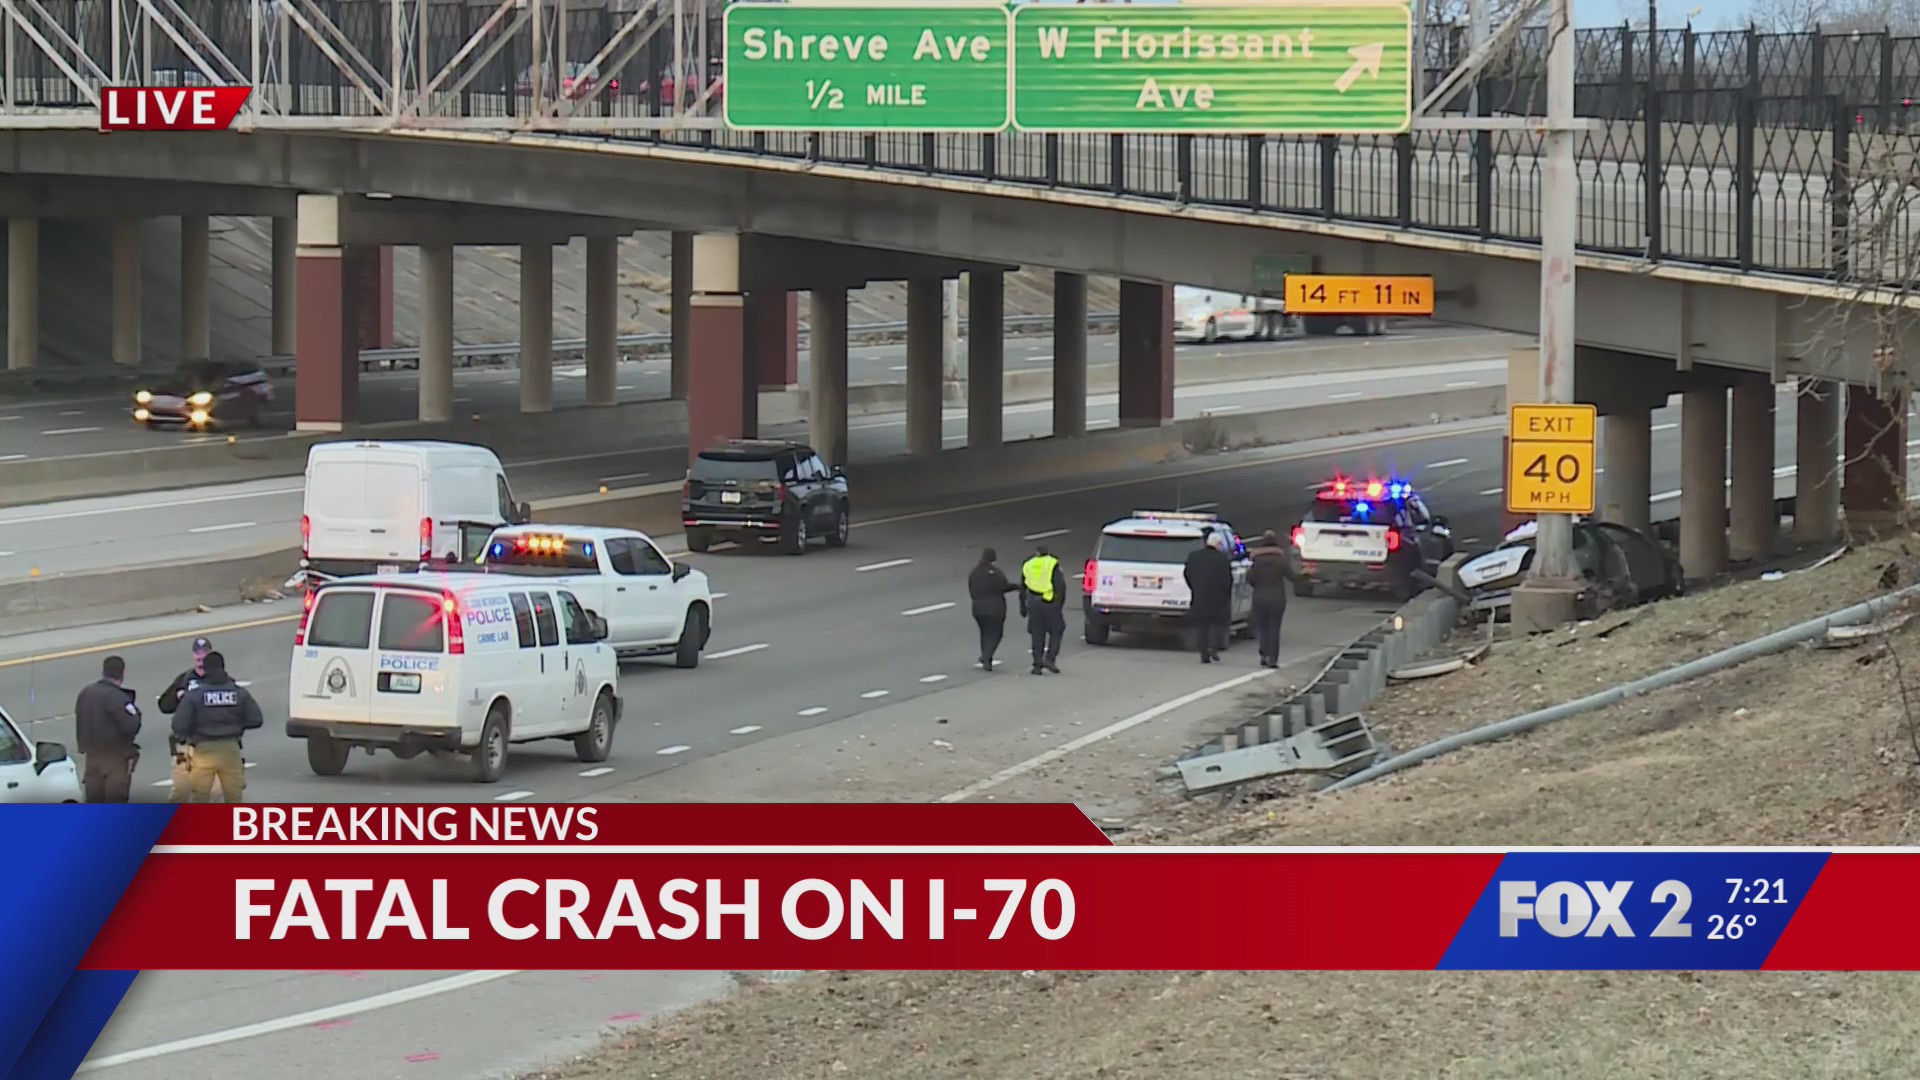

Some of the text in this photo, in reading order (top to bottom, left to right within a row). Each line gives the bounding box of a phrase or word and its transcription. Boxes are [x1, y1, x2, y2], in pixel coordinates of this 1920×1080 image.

[743, 27, 991, 61] Shreve Ave
[1037, 26, 1315, 59] W Florissant
[805, 79, 927, 110] 1/2 MILE
[1135, 77, 1216, 110] Ave
[1300, 284, 1421, 305] 14 FT 11 IN
[1529, 416, 1575, 433] EXIT
[1523, 454, 1580, 484] 40
[1530, 491, 1571, 503] MPH
[466, 607, 512, 627] POLICE
[380, 659, 440, 671] POLICE
[207, 692, 236, 704] POLICE
